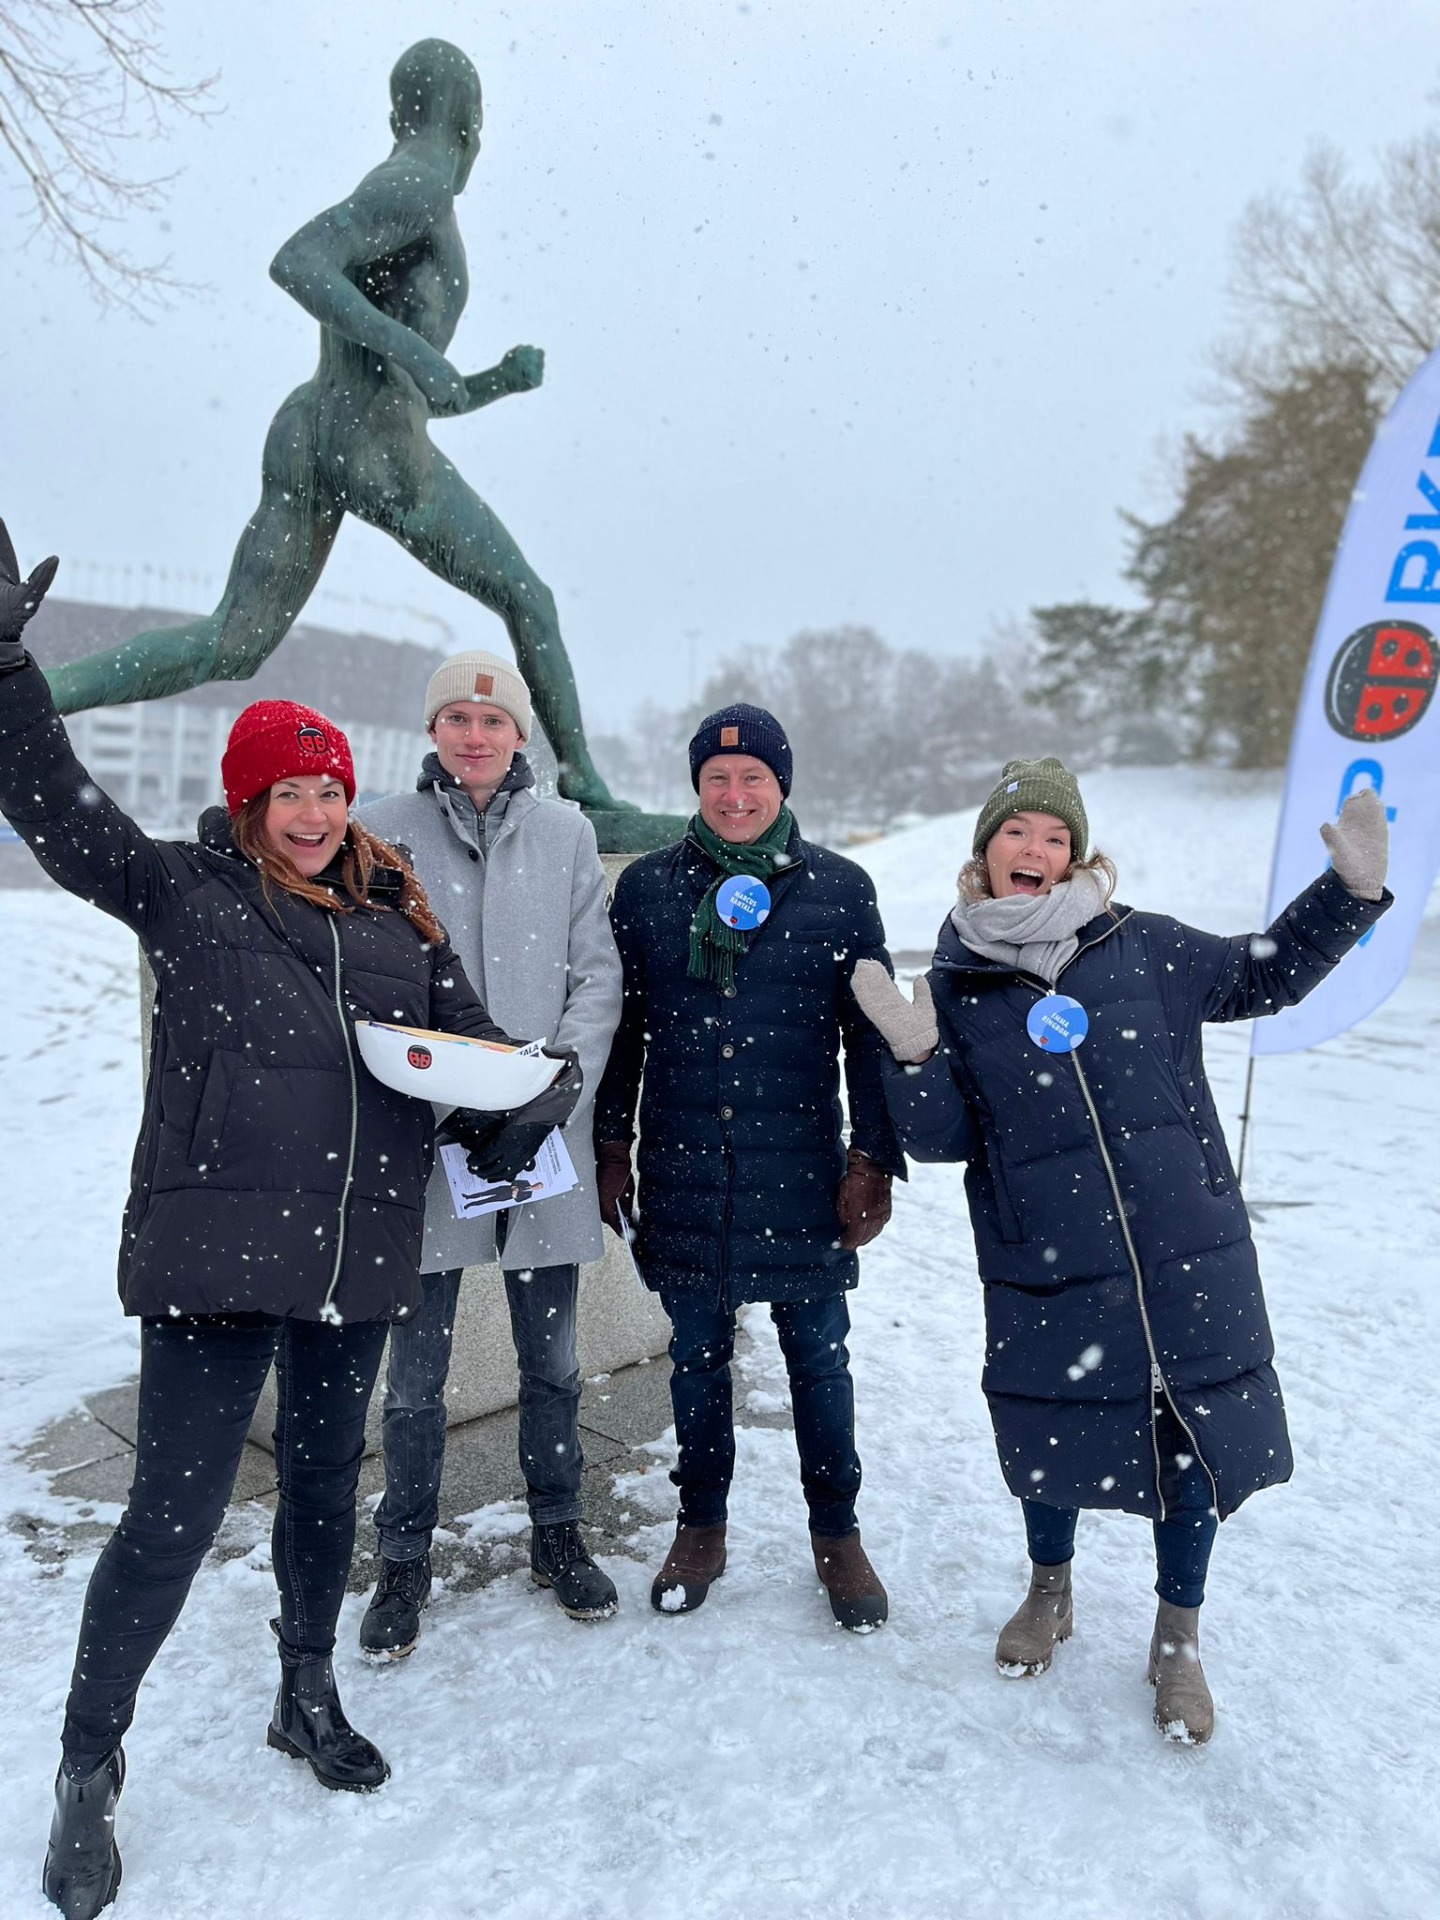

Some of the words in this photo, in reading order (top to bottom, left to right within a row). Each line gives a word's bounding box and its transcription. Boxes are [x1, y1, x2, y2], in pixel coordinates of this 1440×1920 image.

[1384, 413, 1440, 604] RK
[729, 896, 755, 914] RANTALA
[734, 890, 757, 907] MARCUS
[1041, 1015, 1070, 1037] RINGBOM
[1050, 1012, 1070, 1028] EMMA
[517, 1043, 539, 1056] TALA
